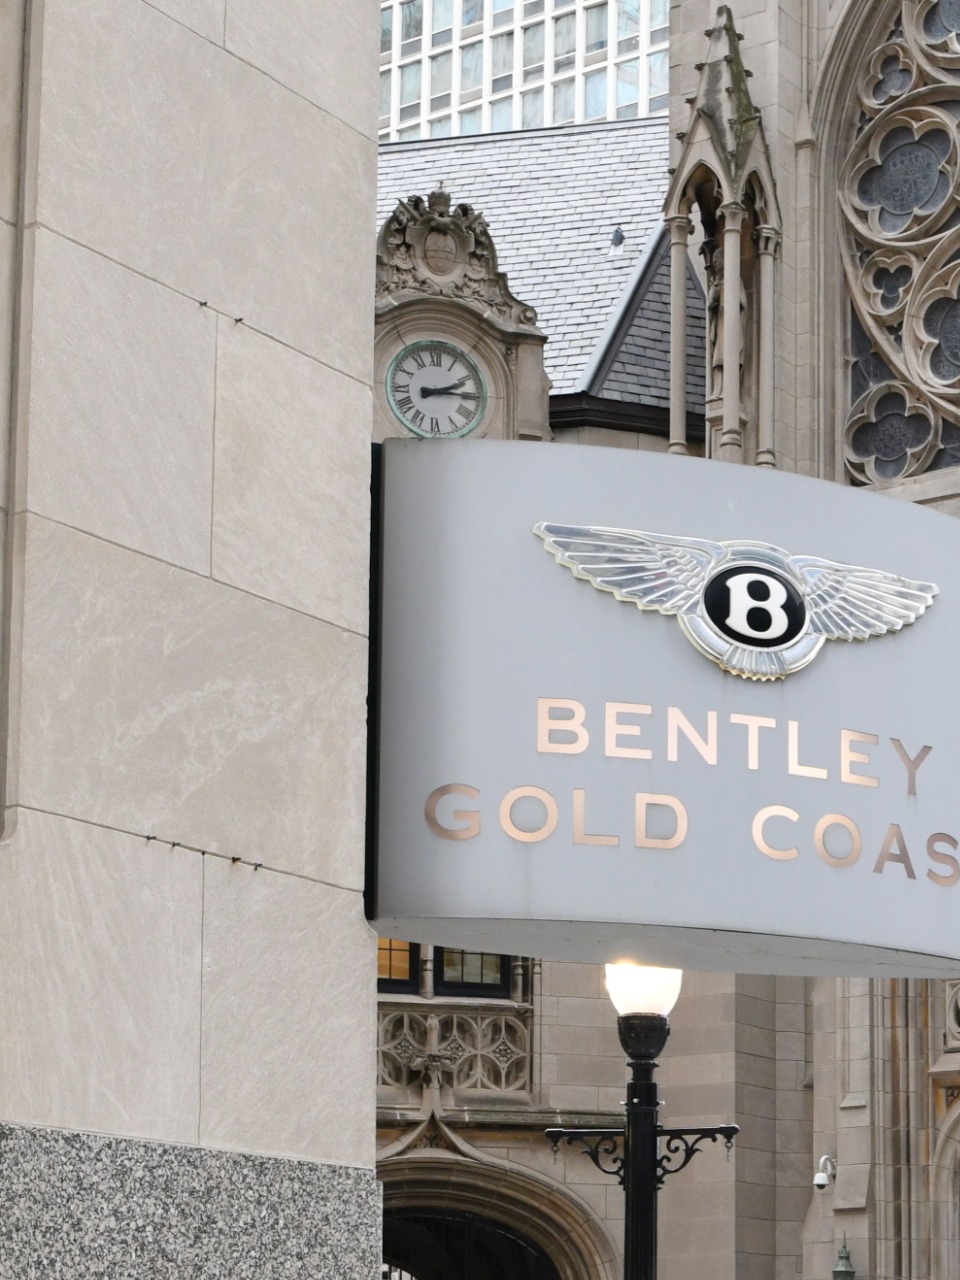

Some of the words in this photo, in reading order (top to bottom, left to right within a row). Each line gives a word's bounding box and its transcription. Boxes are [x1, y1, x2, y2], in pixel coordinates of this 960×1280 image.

[411, 354, 427, 370] XI
[429, 352, 442, 368] XII
[447, 359, 458, 372] I
[397, 364, 415, 380] X
[430, 417, 441, 432] VI
[448, 416, 460, 431] V
[725, 572, 790, 640] B
[537, 697, 933, 796] BENTLEY
[424, 783, 689, 850] GOLD
